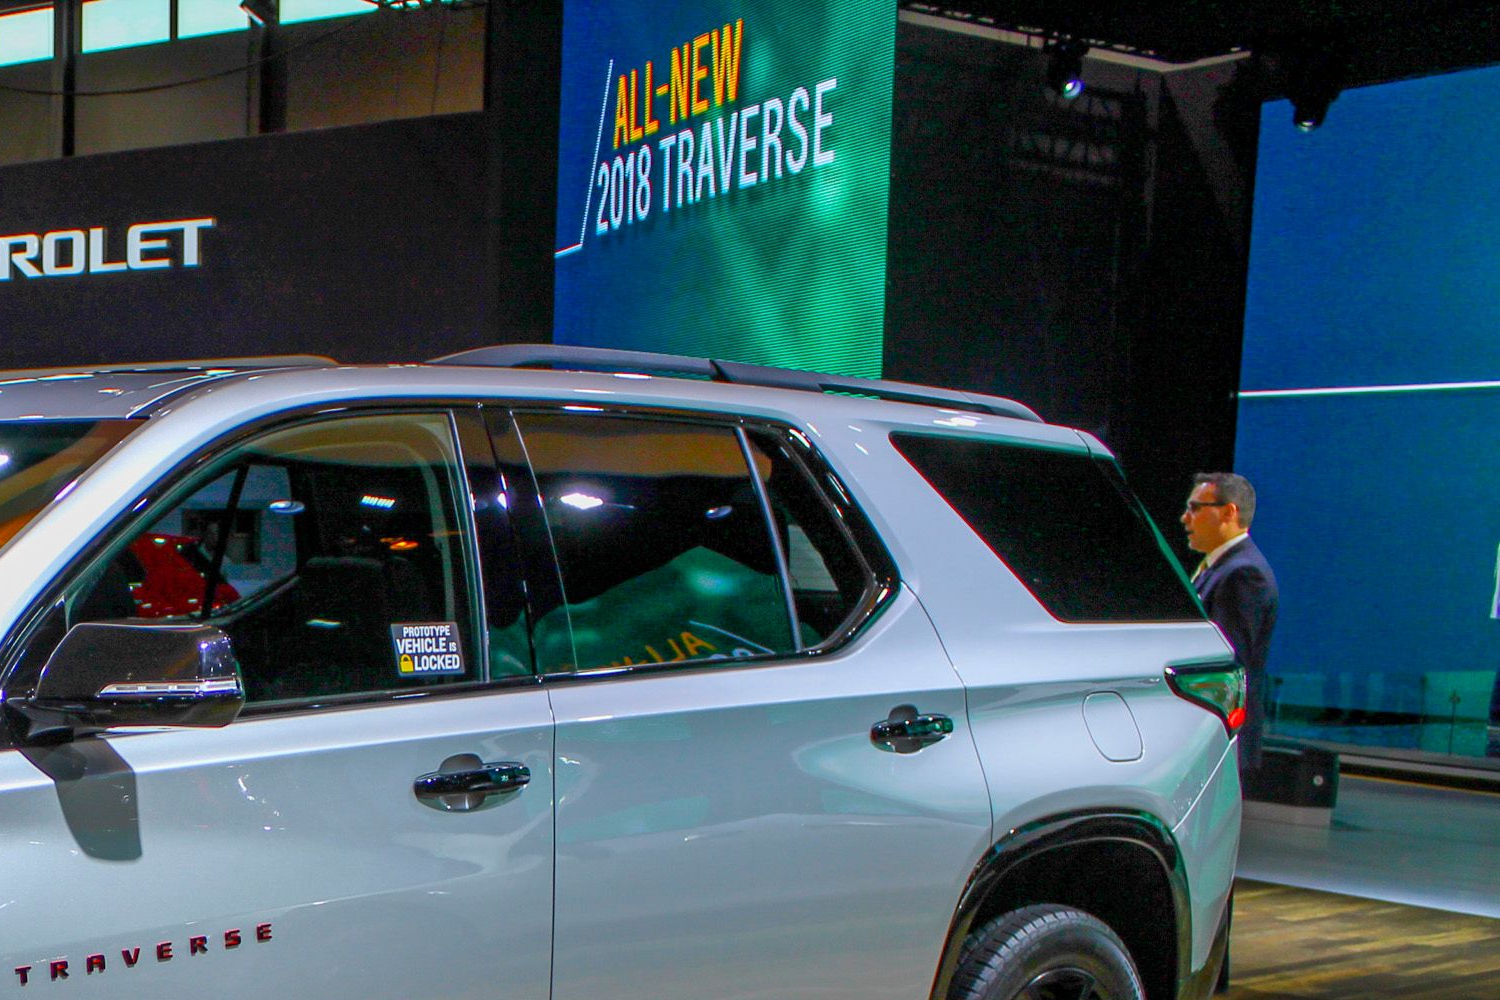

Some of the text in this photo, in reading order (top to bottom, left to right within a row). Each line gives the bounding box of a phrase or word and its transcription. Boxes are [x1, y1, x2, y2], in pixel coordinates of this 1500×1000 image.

[613, 18, 743, 150] ALL-NEW
[596, 76, 837, 236] 2018 TRAVERSE
[396, 637, 457, 654] VEHICLE IS
[402, 624, 451, 638] PROTOTYPE
[414, 654, 460, 672] LOCKED
[14, 922, 273, 986] TRAVERSE
